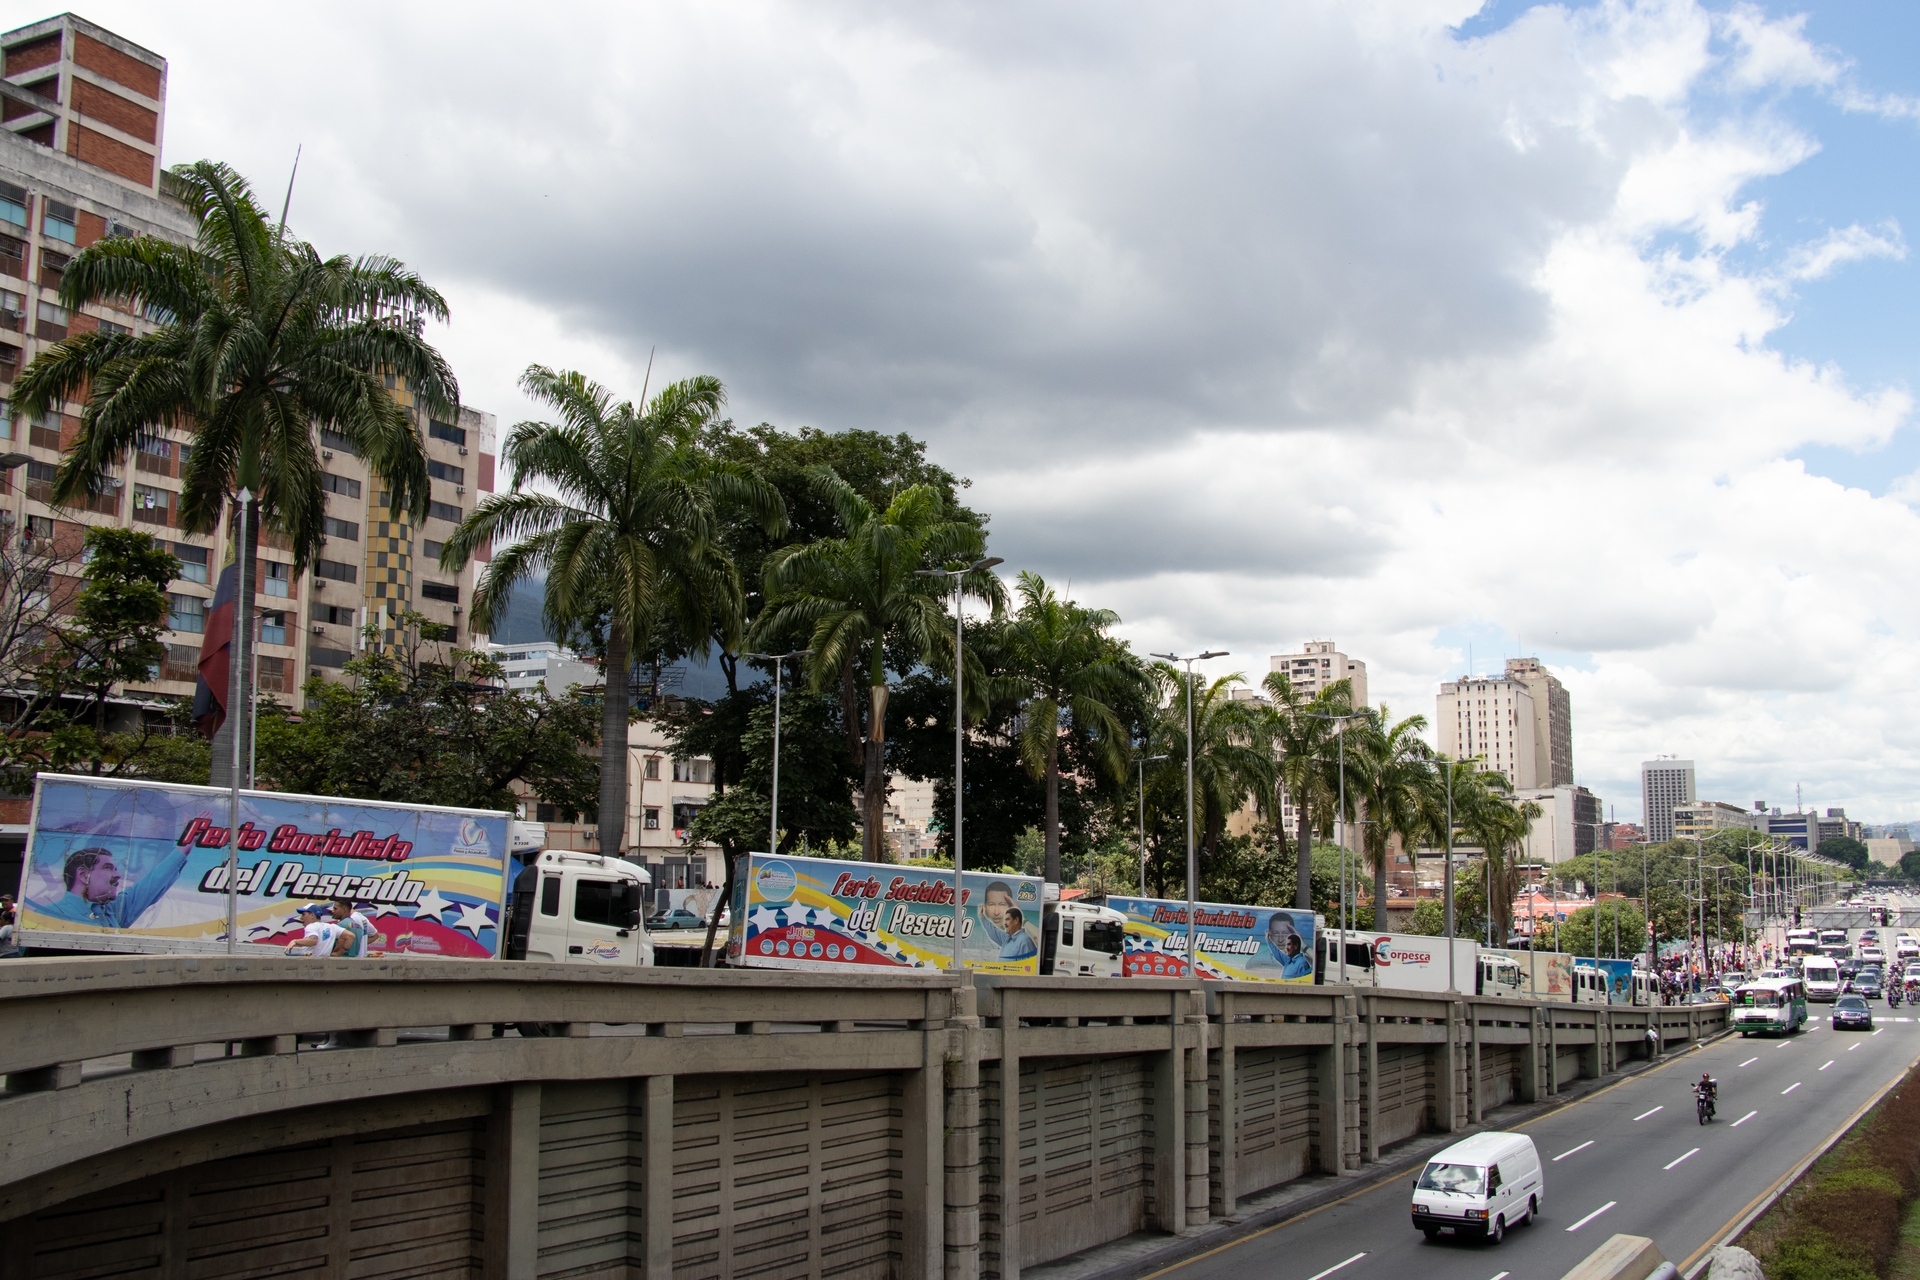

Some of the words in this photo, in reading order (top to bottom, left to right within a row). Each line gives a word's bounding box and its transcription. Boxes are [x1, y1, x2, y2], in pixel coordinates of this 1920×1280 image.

[267, 824, 414, 862] Socialista
[198, 858, 272, 896] del
[263, 861, 426, 903] Pescado
[831, 872, 882, 900] Feria
[847, 900, 886, 933] del
[1152, 905, 1188, 925] Feria
[1193, 908, 1257, 929] Socialista
[1193, 931, 1261, 956] Pescado
[1375, 937, 1430, 966] Corpesca
